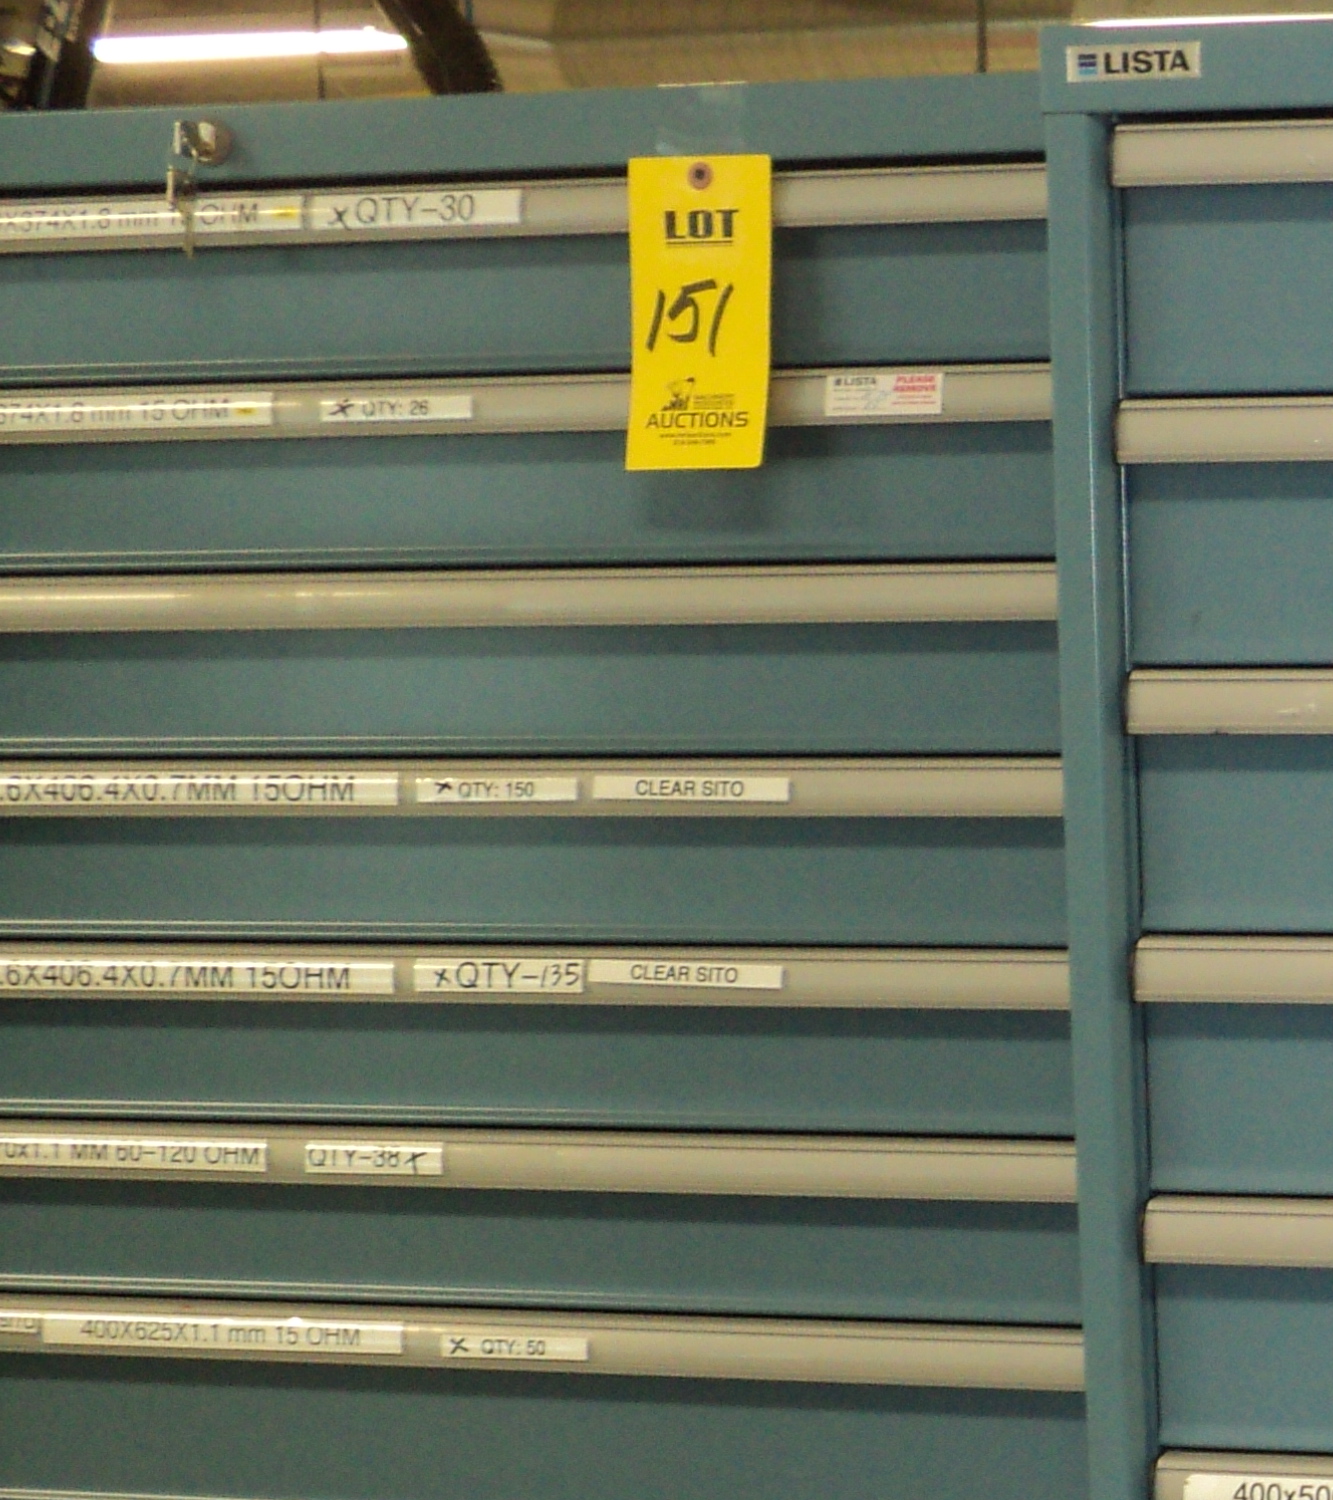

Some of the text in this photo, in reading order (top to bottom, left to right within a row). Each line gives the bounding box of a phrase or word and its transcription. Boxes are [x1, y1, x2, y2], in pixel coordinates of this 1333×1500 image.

[1103, 49, 1190, 74] LISTA
[355, 194, 476, 224] QTY-30
[664, 208, 739, 239] LOT
[645, 278, 734, 357] 151
[645, 410, 749, 429] AUCTIONS
[504, 781, 535, 798] 150
[634, 779, 745, 798] CLEAR SITO
[630, 964, 739, 984] CLEAR SITO
[204, 1146, 260, 1166] OHM
[79, 1318, 360, 1347] 400X625X1.1 mm 15 OHM
[526, 1338, 546, 1357] 50
